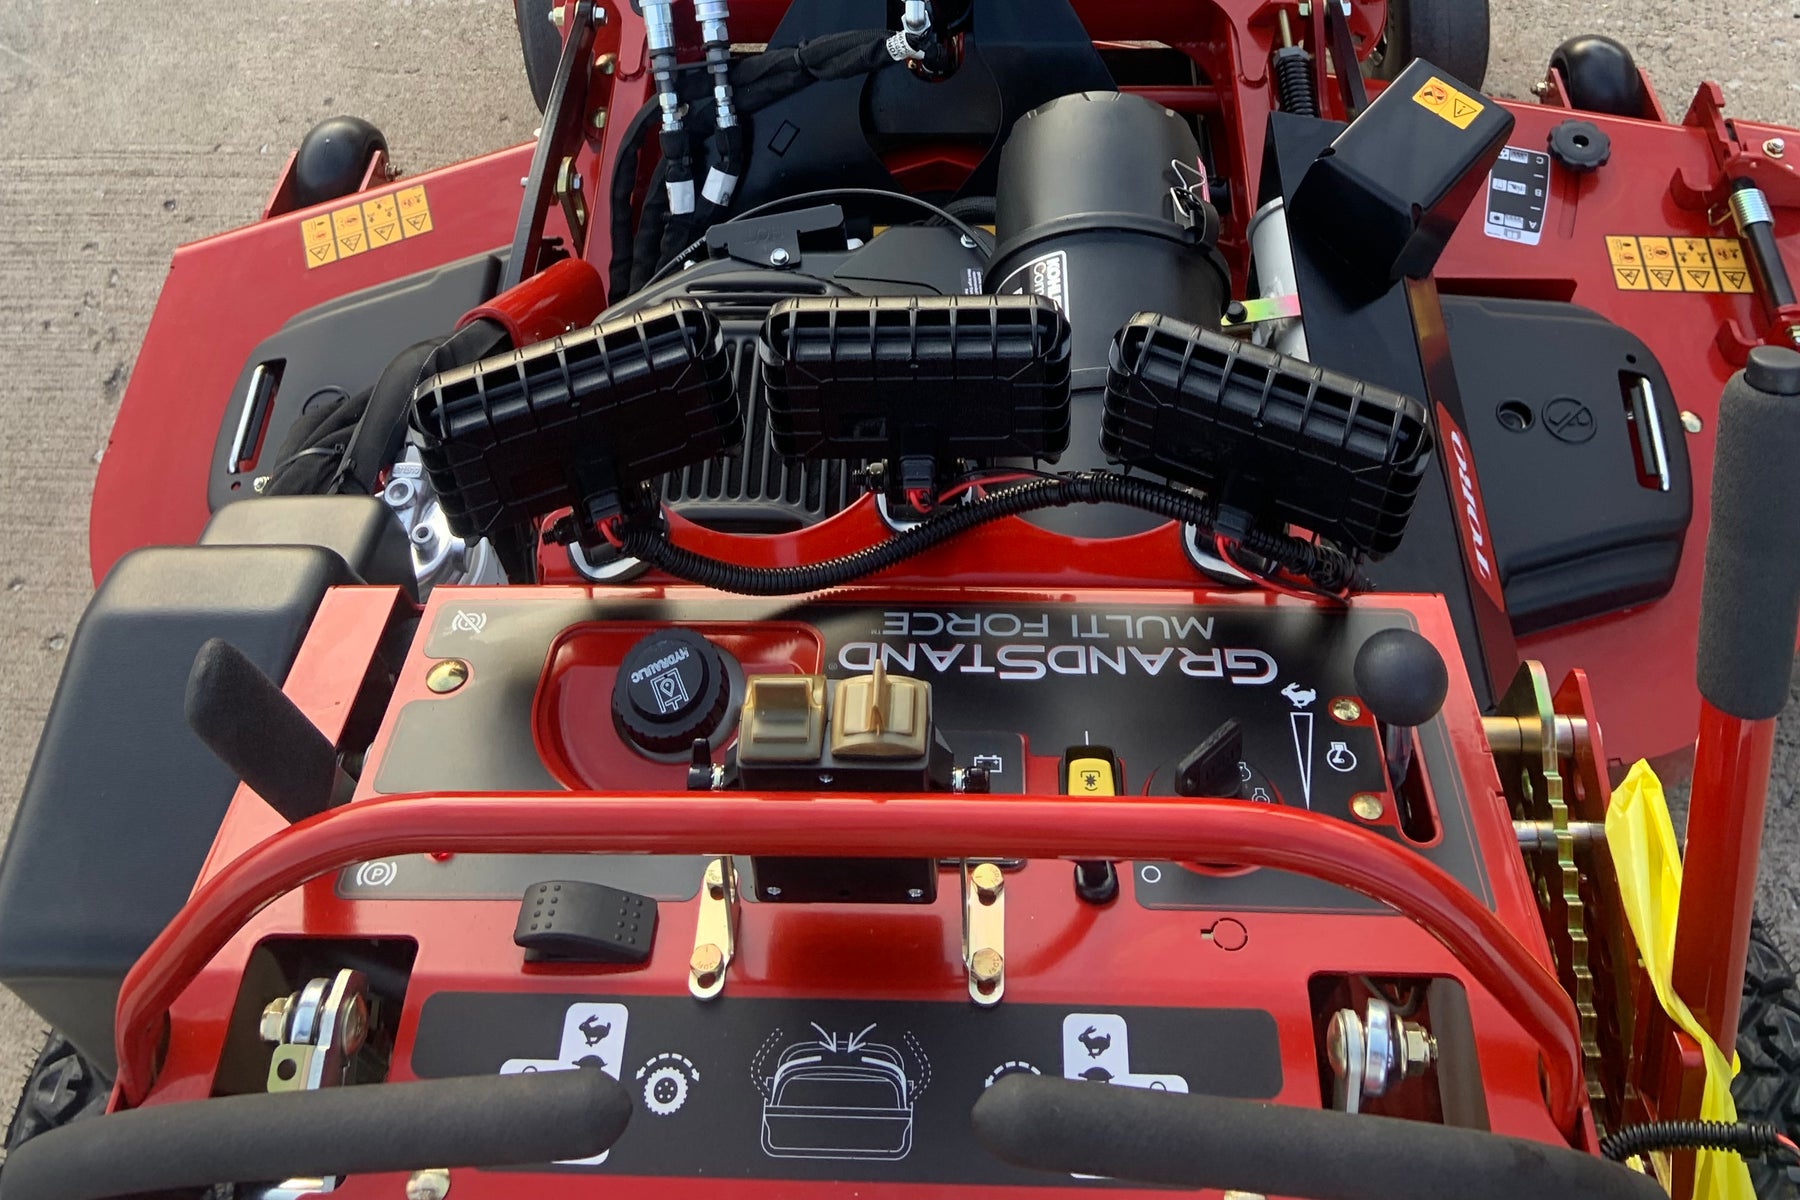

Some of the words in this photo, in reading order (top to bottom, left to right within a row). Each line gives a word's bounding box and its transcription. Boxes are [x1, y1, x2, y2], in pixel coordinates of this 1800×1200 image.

[1529, 220, 1537, 229] A
[1451, 430, 1492, 581] TORO
[882, 612, 1048, 637] FORCE
[1071, 614, 1214, 639] MULTI
[631, 647, 689, 683] HYDRAULIC
